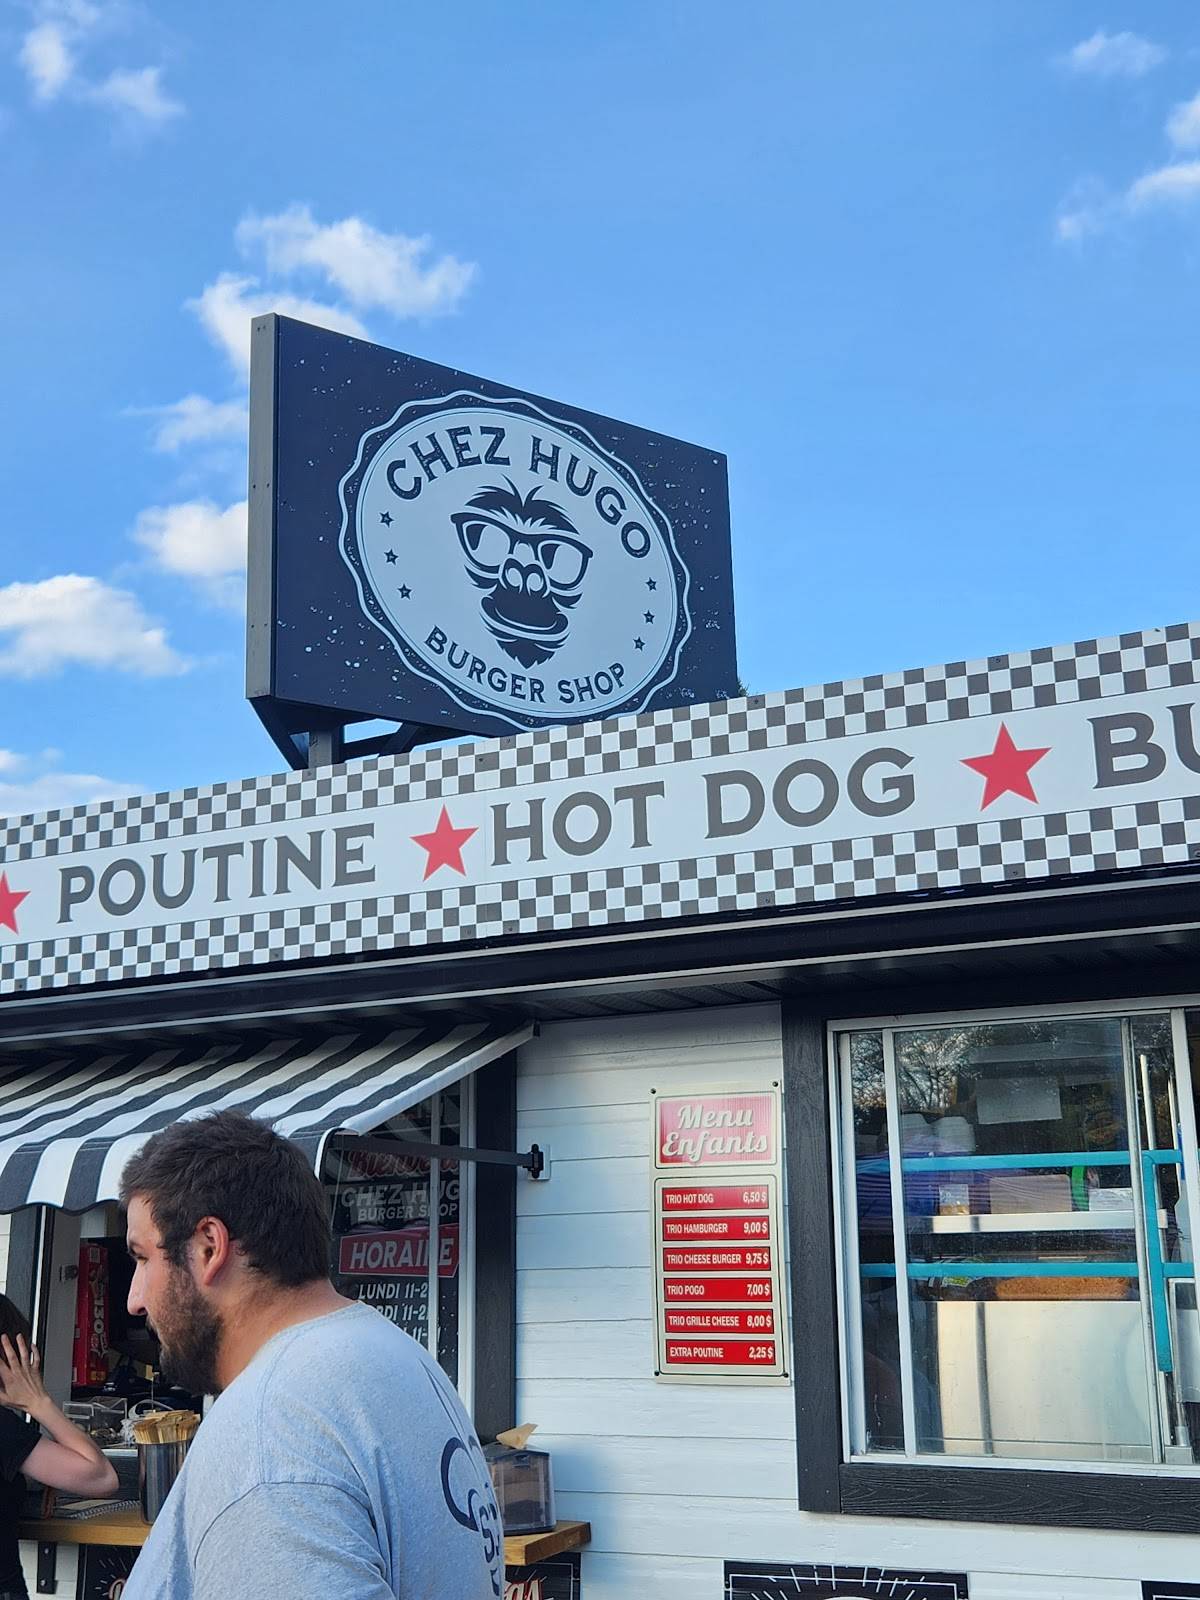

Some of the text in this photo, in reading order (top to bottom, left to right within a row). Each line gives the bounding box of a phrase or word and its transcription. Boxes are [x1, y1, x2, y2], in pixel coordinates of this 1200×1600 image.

[385, 425, 651, 559] CHEZ HUGO
[424, 625, 626, 704] BURGER SHOP
[56, 822, 377, 924] POUTINE
[489, 780, 665, 867] HOT
[702, 747, 915, 840] DOG
[677, 1103, 754, 1130] Menu
[661, 1130, 768, 1163] Enfants
[341, 1180, 459, 1207] CHEZ HG
[666, 1194, 682, 1204] TRIO
[683, 1194, 697, 1204] HOT
[698, 1193, 714, 1204] DOG
[357, 1202, 458, 1221] BURGER SOP
[666, 1224, 682, 1234] TRIO
[684, 1223, 728, 1234] HAMBURGER
[667, 1254, 683, 1264] TRIO
[684, 1254, 711, 1264] CHEESE
[712, 1254, 742, 1264] BURGER
[358, 1282, 428, 1299] LUNDI 11-2
[667, 1285, 683, 1295] TRIO
[684, 1285, 705, 1295] POGO
[402, 1304, 428, 1320] 11-2
[669, 1316, 685, 1326] TRIO
[686, 1316, 711, 1326] GRILLE
[711, 1316, 740, 1327] CHEESE
[670, 1347, 692, 1357] EXTRA
[693, 1347, 724, 1358] POUTINE
